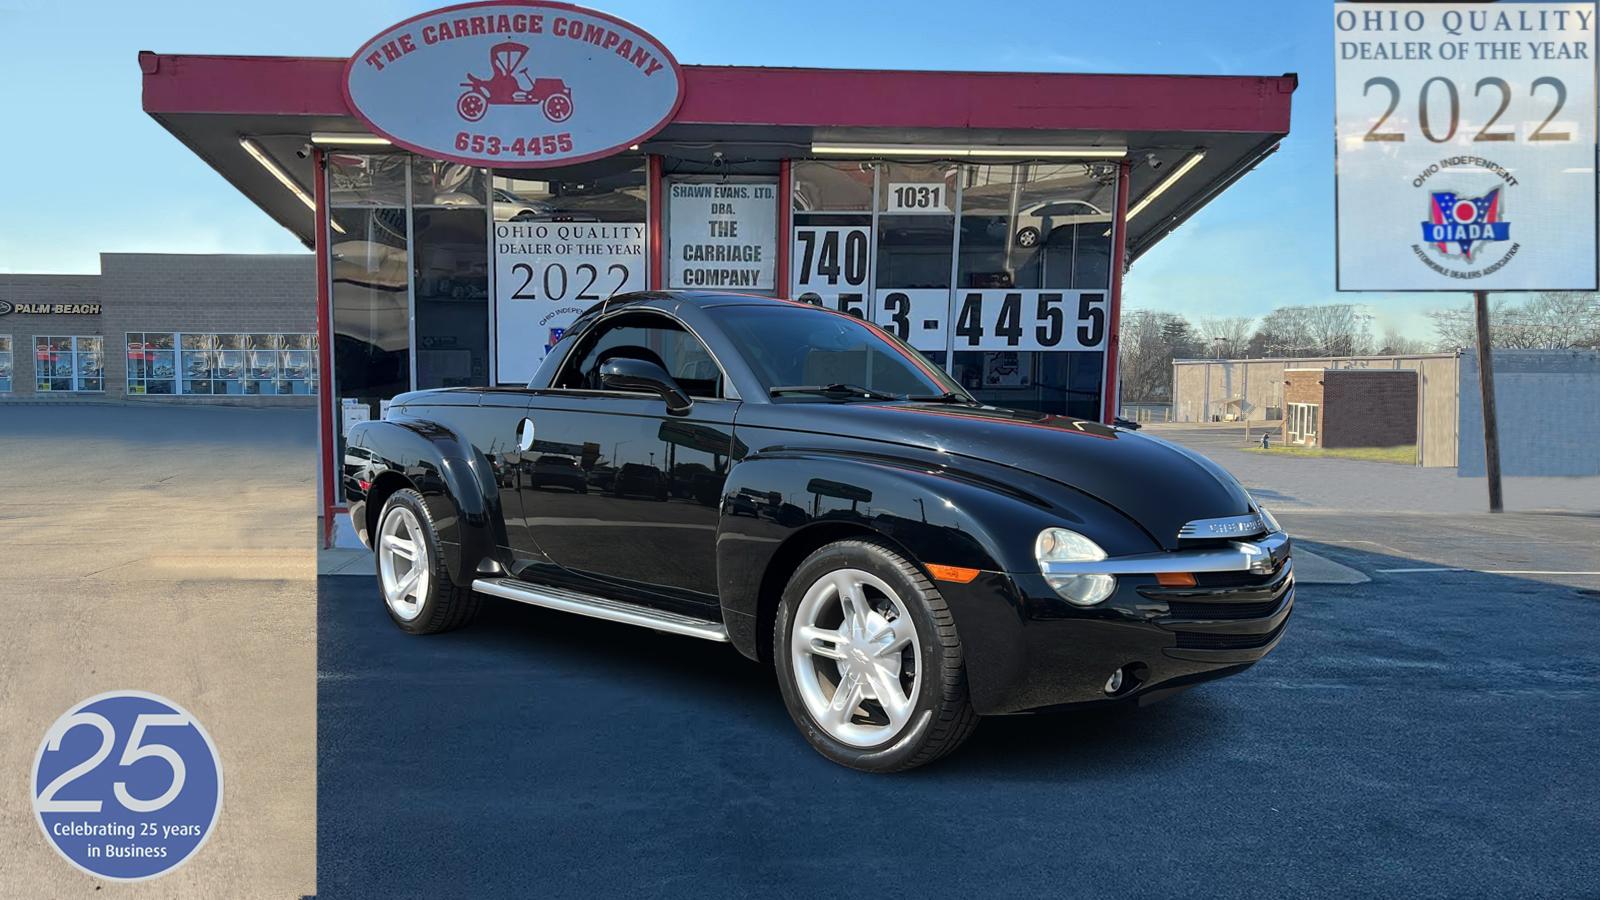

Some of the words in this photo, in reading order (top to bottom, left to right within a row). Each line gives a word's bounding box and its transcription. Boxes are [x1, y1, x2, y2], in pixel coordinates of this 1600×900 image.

[1336, 10, 1425, 32] OHIO
[1443, 10, 1592, 35] QUALITY
[366, 34, 416, 72] THE
[422, 14, 544, 45] CARRIAGE
[552, 16, 665, 77] COMPANY
[1341, 41, 1432, 60] DEALER
[1439, 41, 1469, 60] OF
[1475, 41, 1522, 60] THE
[1528, 41, 1589, 60] YEAR
[1363, 76, 1571, 143] 2022
[455, 131, 573, 156] 653-4455
[1412, 164, 1439, 188] OHIO
[1440, 156, 1519, 187] INDEPENDENT
[672, 186, 712, 198] SHAWN
[754, 188, 774, 199] LTD.
[894, 186, 940, 208] 1031
[711, 203, 735, 214] DBA.
[496, 226, 549, 239] OHIO
[557, 226, 644, 242] QUALITY
[709, 221, 738, 238] THE
[1432, 225, 1495, 240] OIADA
[498, 243, 552, 255] DEALER
[554, 243, 574, 255] OF
[575, 243, 603, 255] THE
[605, 243, 642, 255] YEAR
[683, 244, 762, 262] CARRIAGE
[797, 230, 867, 286] 740
[1411, 244, 1449, 277] AUTOMOBILE
[1450, 269, 1482, 280] DEALERS
[1483, 242, 1520, 276] ASSOCIATION
[510, 262, 631, 300] 2022
[683, 268, 761, 286] COMPANY
[14, 303, 51, 314] PALM
[54, 304, 100, 314] BEACH
[539, 312, 556, 326] OHIO
[798, 292, 1105, 347] 3-4455
